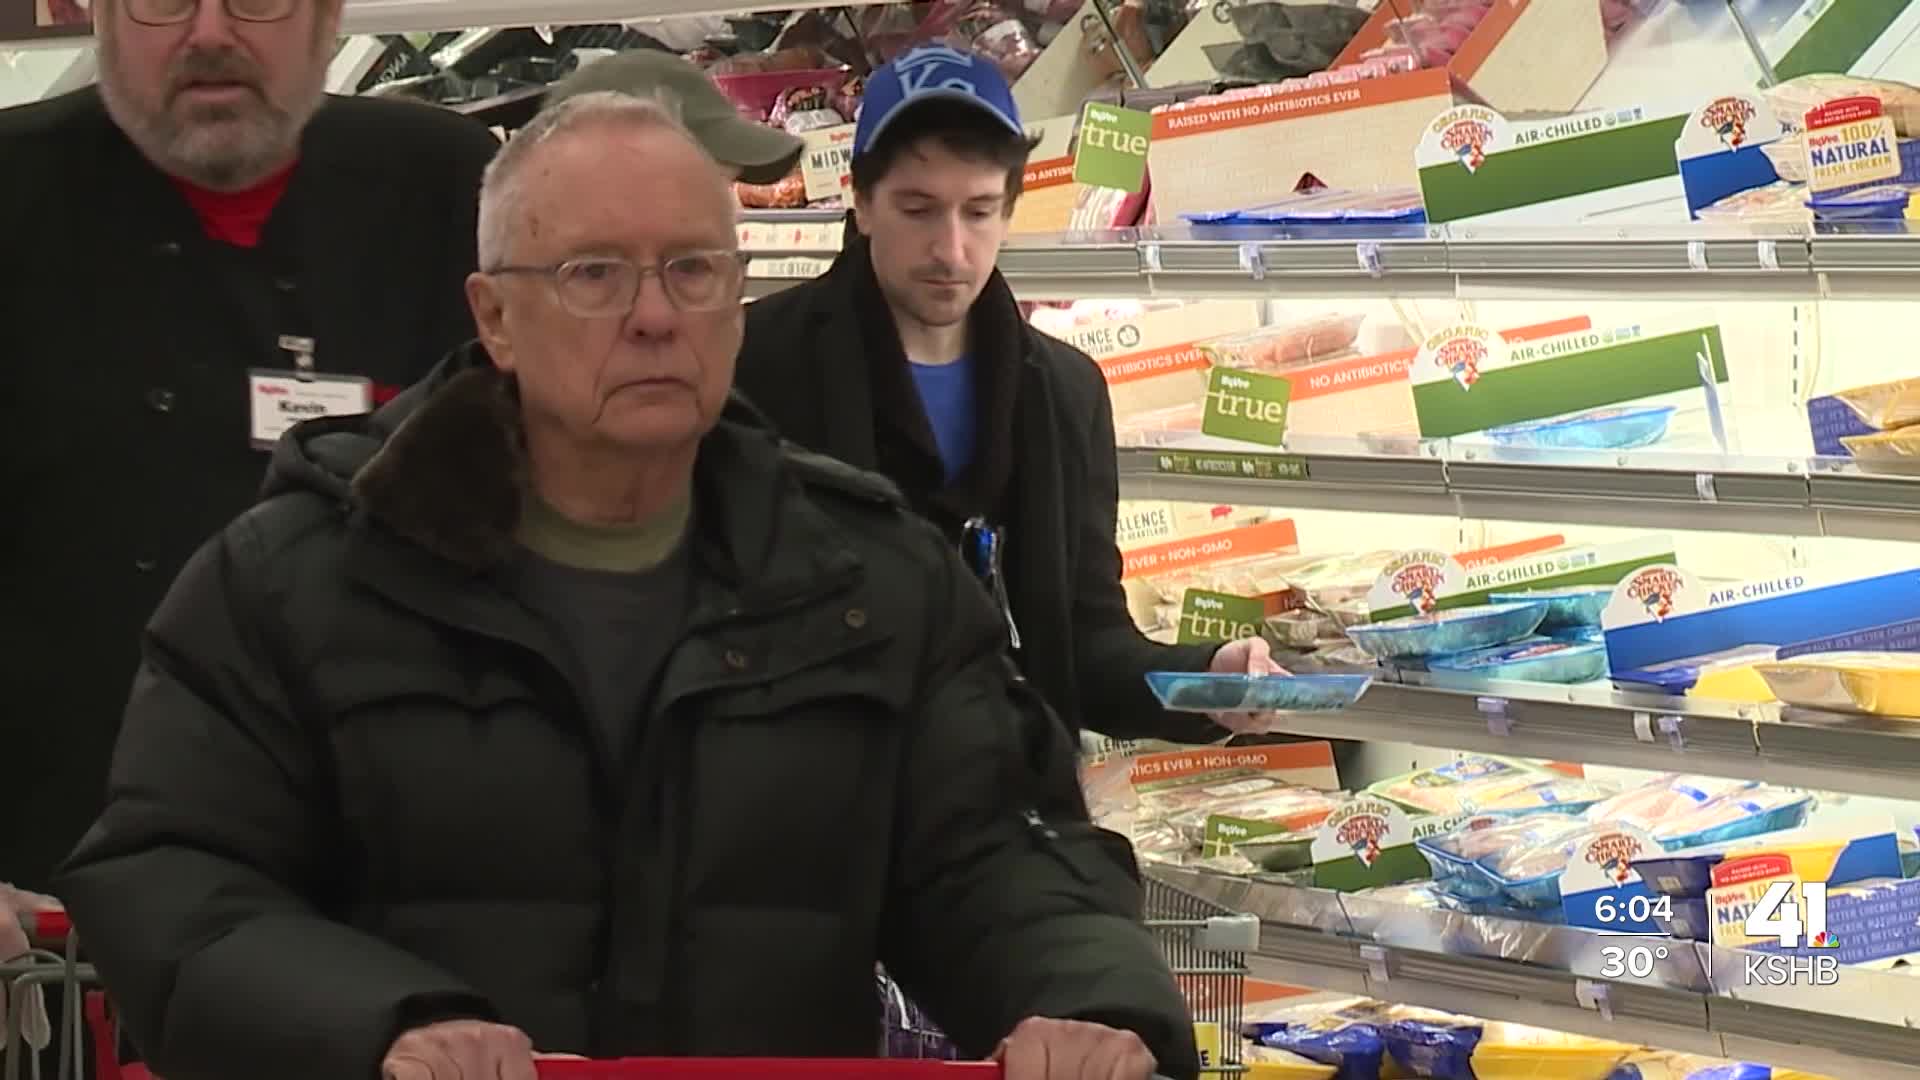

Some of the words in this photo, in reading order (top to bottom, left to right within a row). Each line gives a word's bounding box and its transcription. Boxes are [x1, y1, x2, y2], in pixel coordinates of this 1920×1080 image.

[1168, 112, 1208, 129] RAISED
[1209, 107, 1241, 122] WITH
[1243, 105, 1260, 118] NO
[1262, 94, 1331, 116] ANTIBIOTICS
[1332, 88, 1361, 105] EVER
[1083, 122, 1147, 155] true
[1842, 122, 1886, 143] 100%
[1811, 137, 1890, 167] NATURAL
[1310, 375, 1330, 389] NO
[1210, 389, 1282, 424] true
[1129, 556, 1157, 571] EVER
[1168, 540, 1233, 562] NON-GMO
[1186, 611, 1255, 642] true
[1163, 755, 1193, 774] EVER
[1203, 753, 1268, 769] NON-GMO
